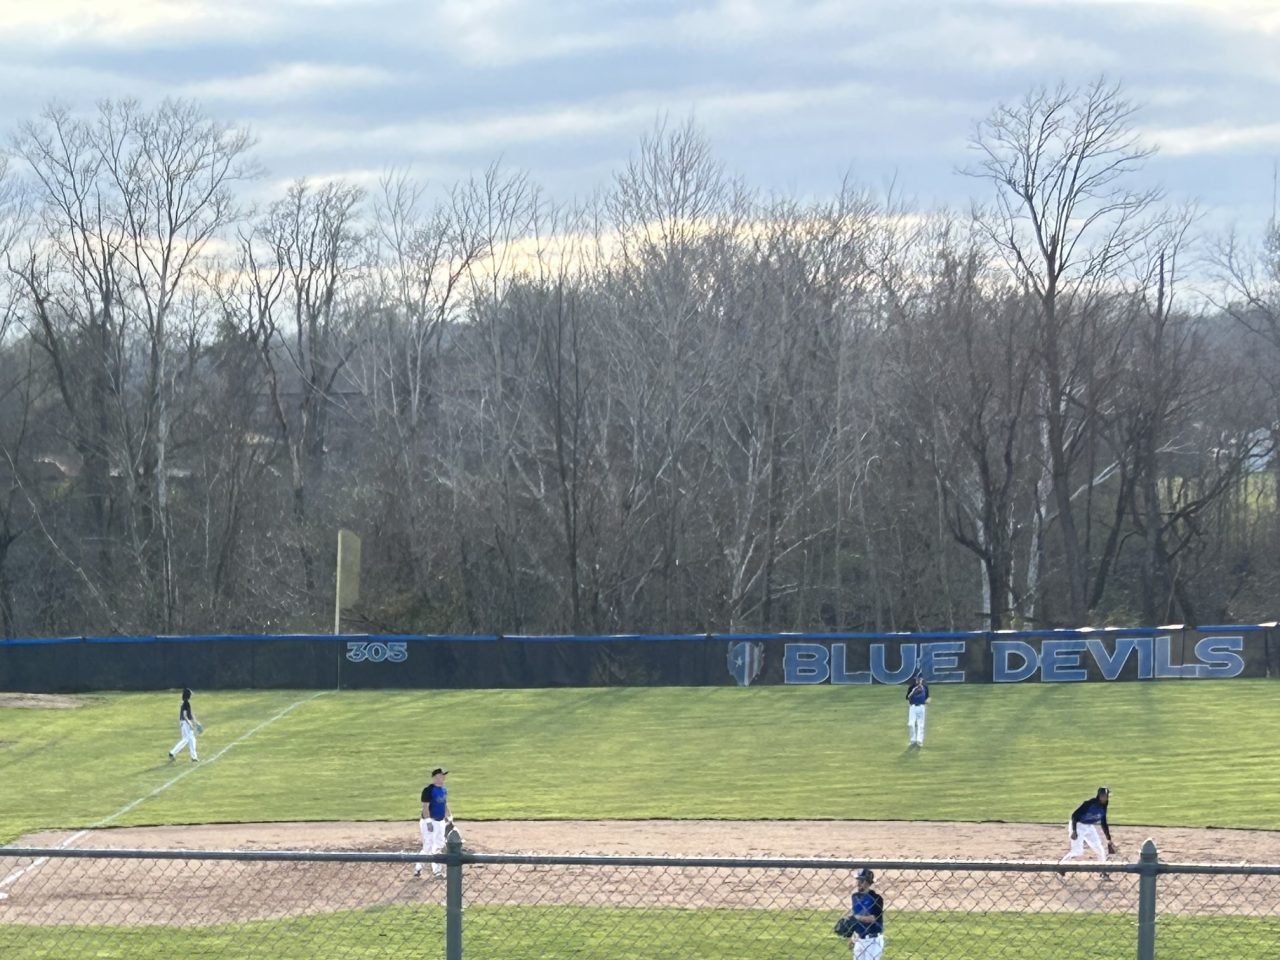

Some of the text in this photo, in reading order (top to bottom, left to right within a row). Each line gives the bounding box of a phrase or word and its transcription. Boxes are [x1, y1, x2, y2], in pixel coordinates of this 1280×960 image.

[346, 642, 408, 662] 305
[783, 636, 1245, 685] BLUE DEVILS
